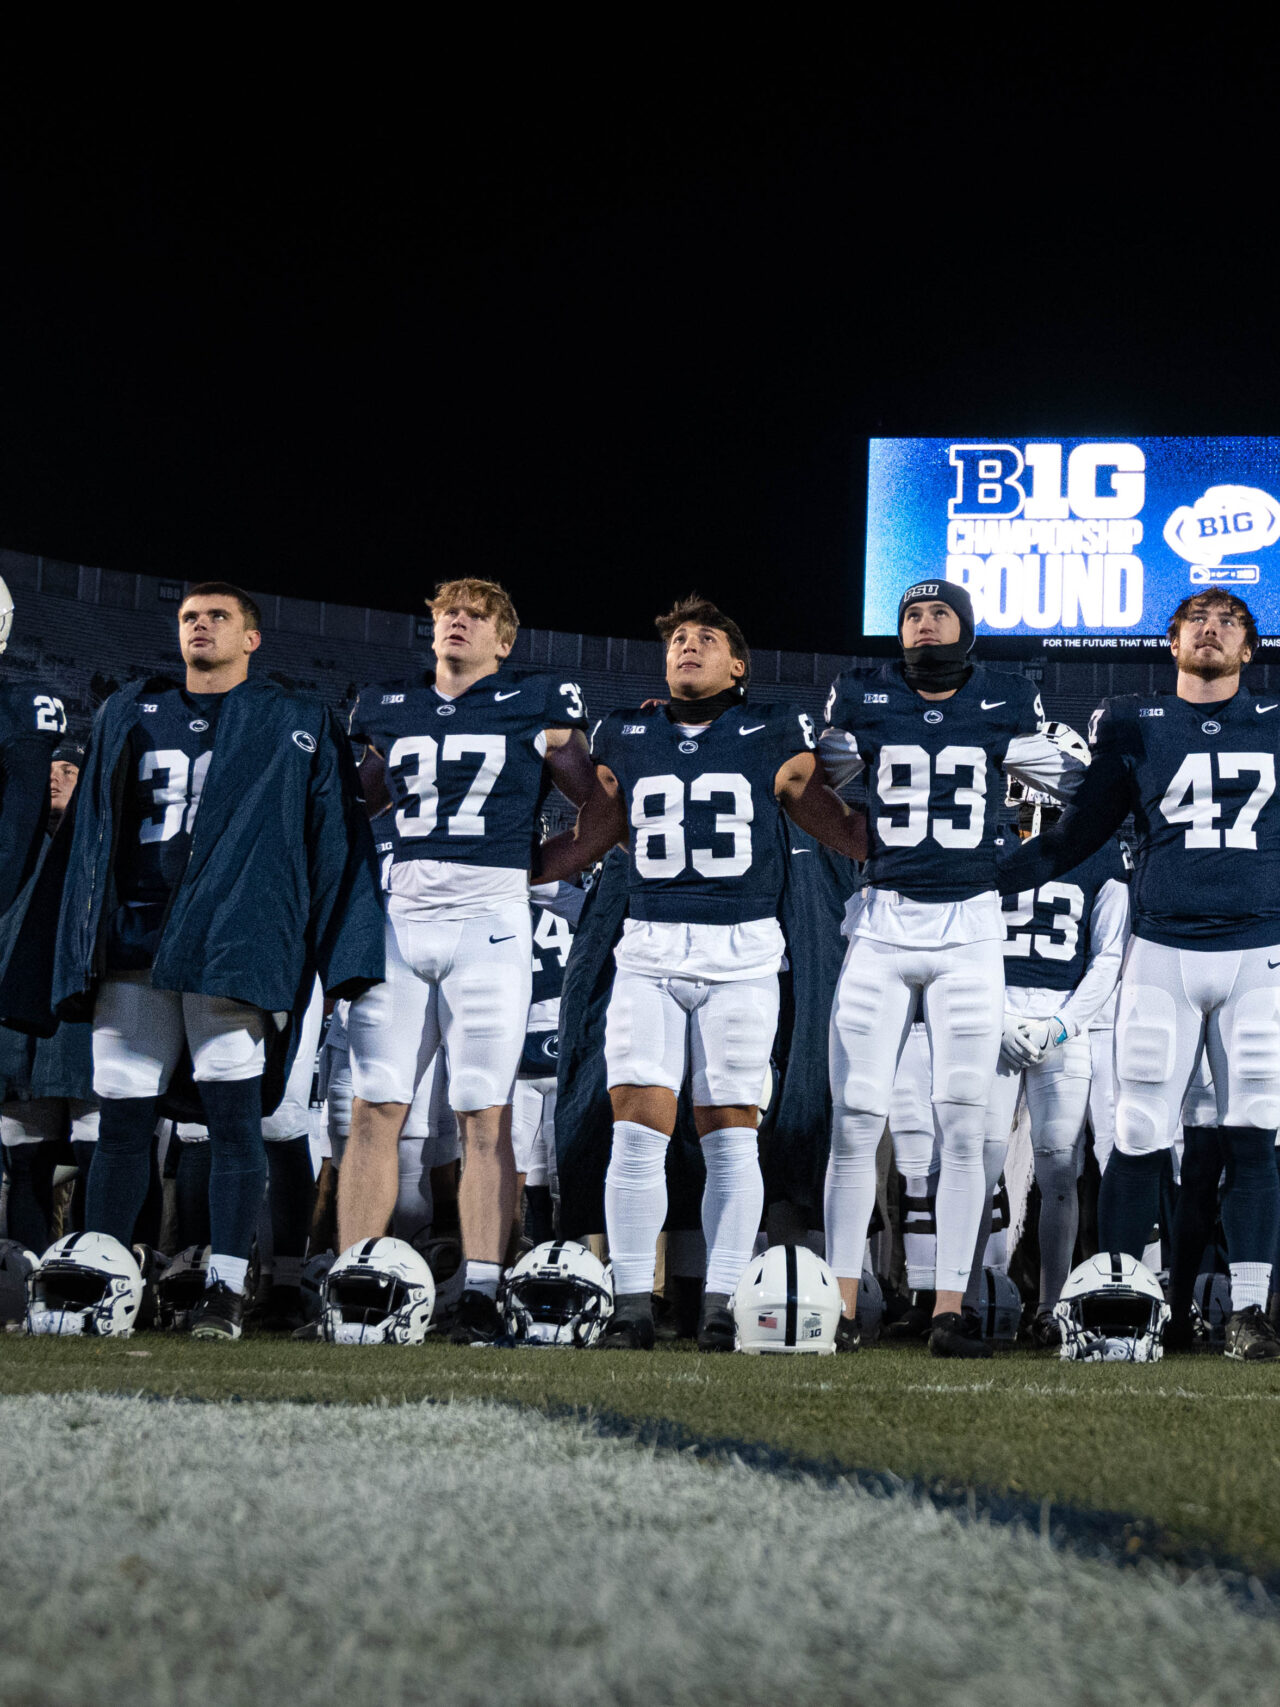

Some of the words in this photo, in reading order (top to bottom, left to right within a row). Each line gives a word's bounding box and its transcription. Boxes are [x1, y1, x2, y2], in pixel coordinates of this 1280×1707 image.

[948, 519, 1144, 555] CHAMPIONSHIP
[904, 584, 939, 603] PSU
[1043, 639, 1062, 647] FOR
[1064, 639, 1080, 647] THE
[1083, 639, 1117, 647] FUTURE
[1119, 639, 1141, 647] THAT
[1143, 639, 1157, 647] WE
[559, 683, 588, 718] 3
[389, 734, 506, 837] 37
[877, 745, 988, 848] 93
[1159, 752, 1276, 850] 47
[631, 773, 754, 878] 83
